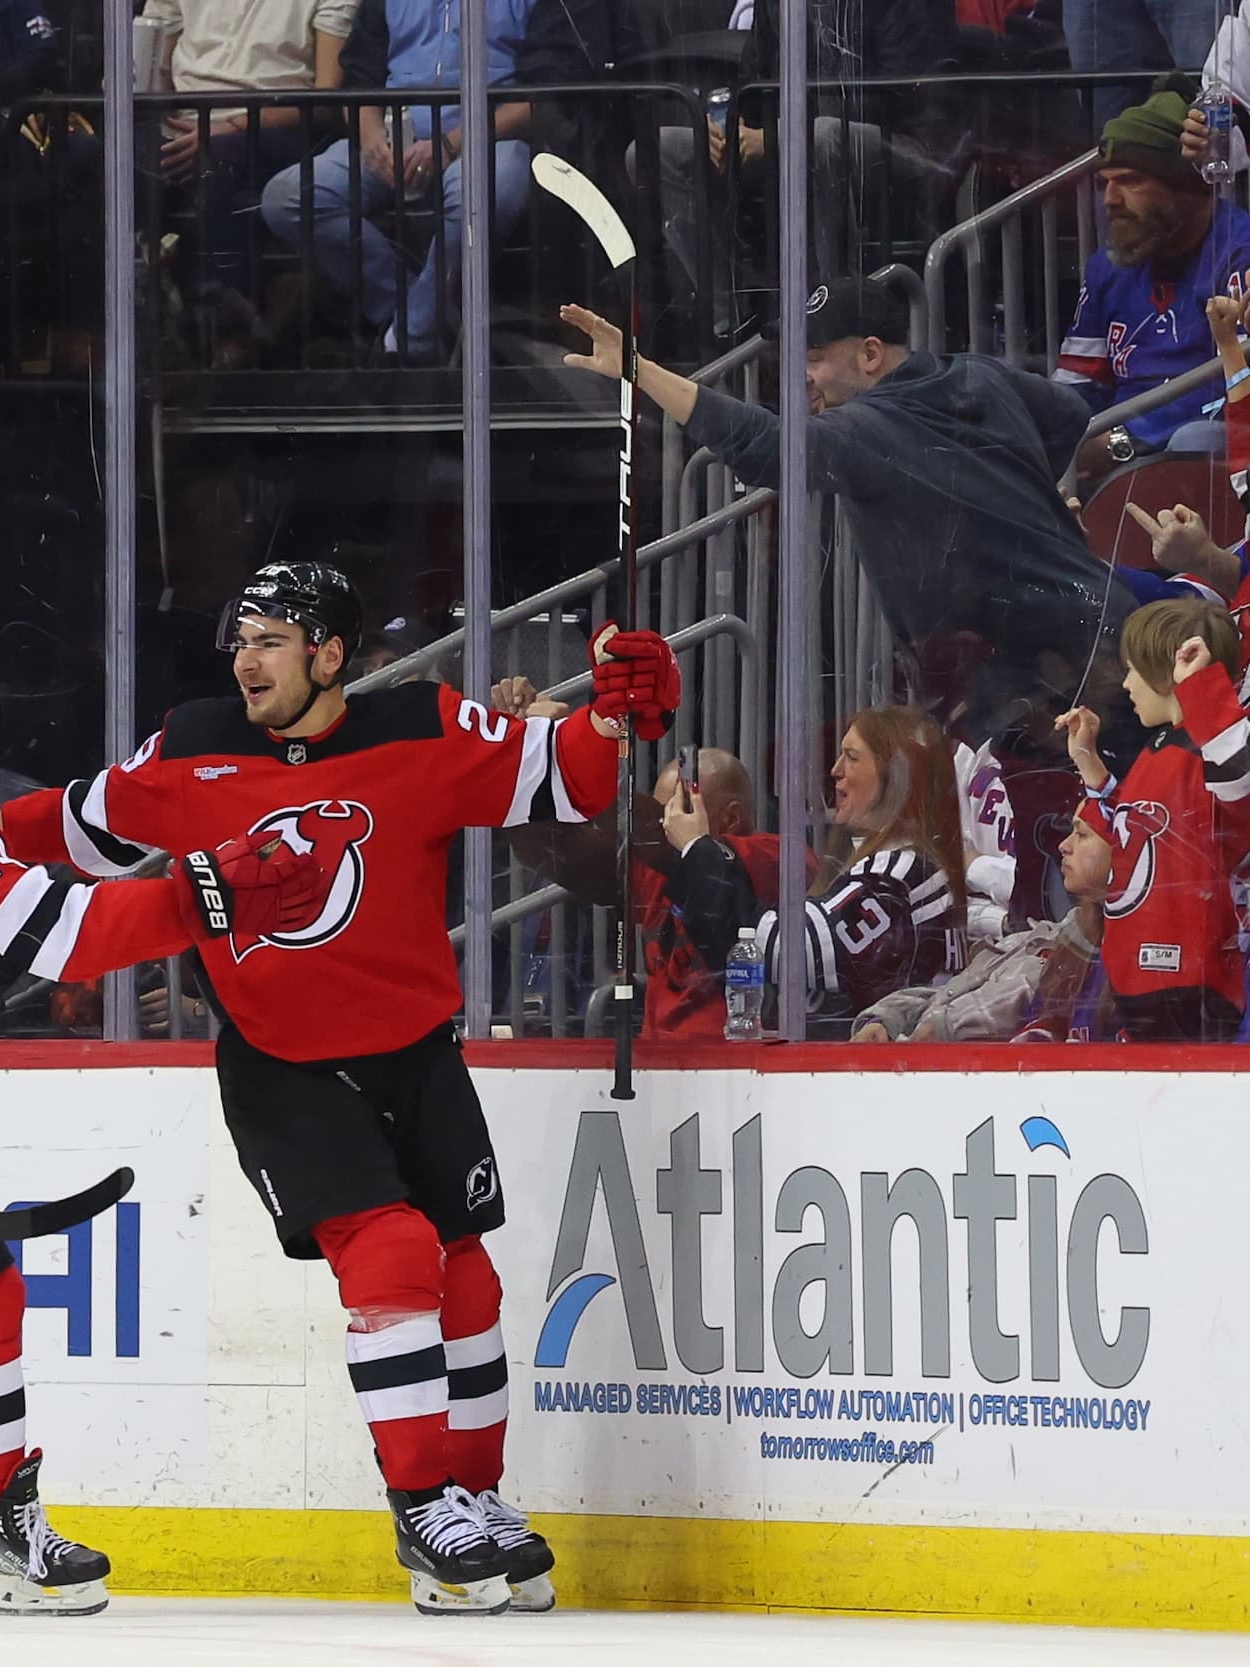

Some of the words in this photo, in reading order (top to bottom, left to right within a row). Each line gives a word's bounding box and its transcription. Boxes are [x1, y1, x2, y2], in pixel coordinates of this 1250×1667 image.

[619, 377, 632, 551] TRUE
[187, 850, 228, 928] BAUE
[535, 1112, 1150, 1388] Atlantic
[535, 1381, 632, 1413] MANAGED
[636, 1383, 721, 1416] SERVICES
[734, 1386, 834, 1420] WORKFLOW
[837, 1389, 955, 1424] AUTOMATION
[969, 1393, 1028, 1426] OFFICE
[1029, 1397, 1150, 1431] TECHNOLOGY
[760, 1431, 934, 1465] tomorrowsoffice.com
